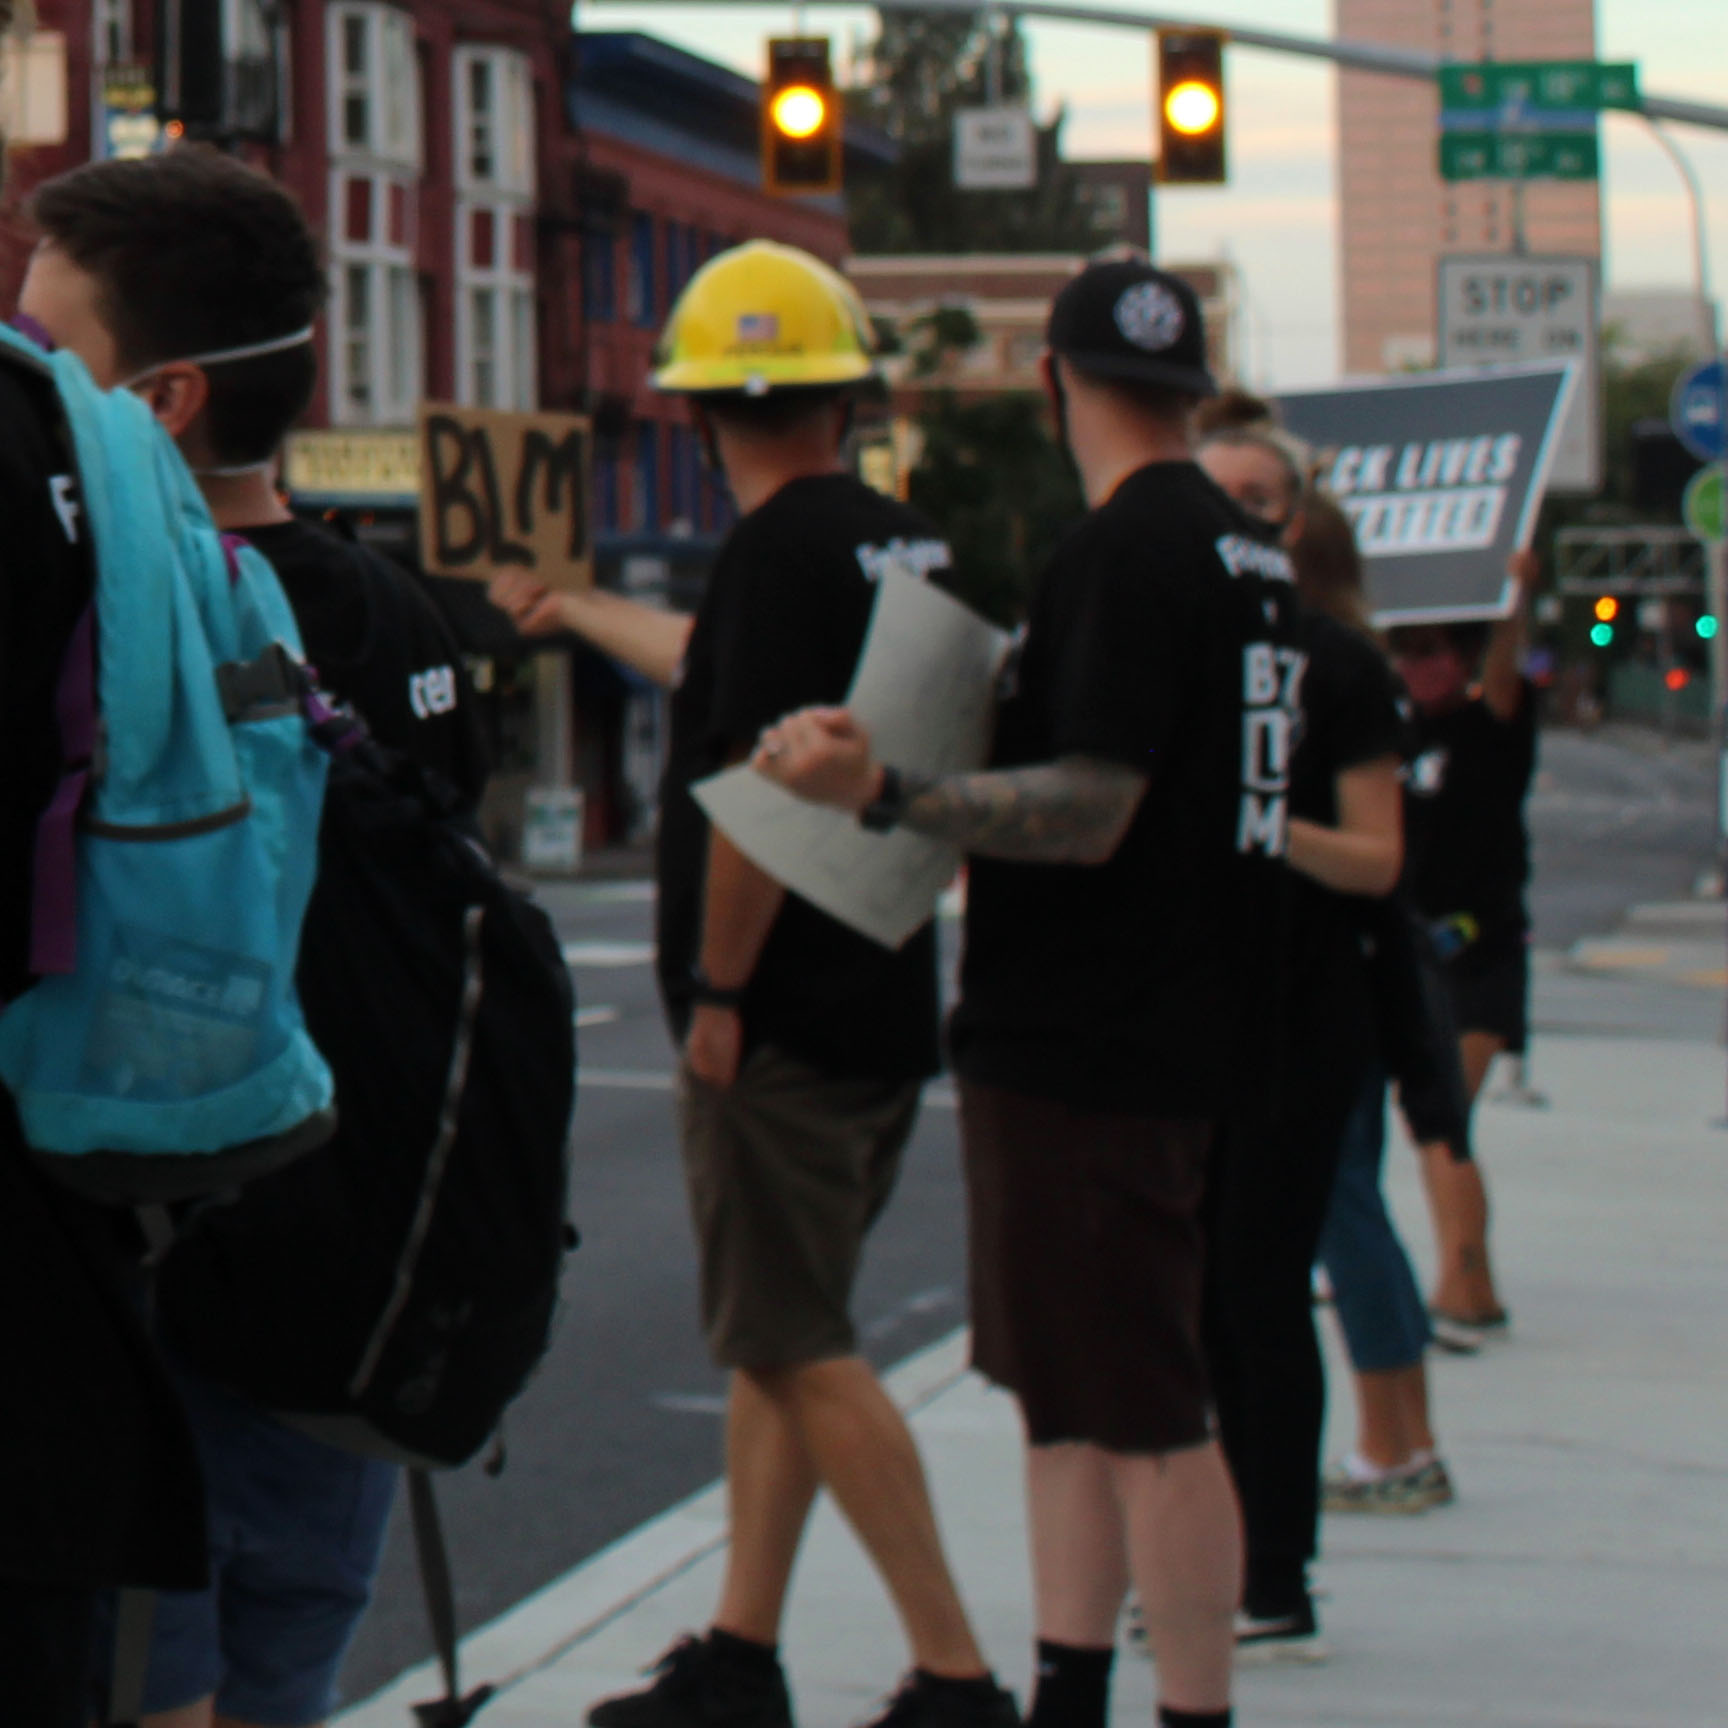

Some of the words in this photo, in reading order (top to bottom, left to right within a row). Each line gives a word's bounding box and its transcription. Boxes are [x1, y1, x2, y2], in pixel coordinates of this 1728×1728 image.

[1461, 275, 1575, 316] STOP
[426, 414, 586, 569] BLM
[1395, 431, 1522, 492] LIVES
